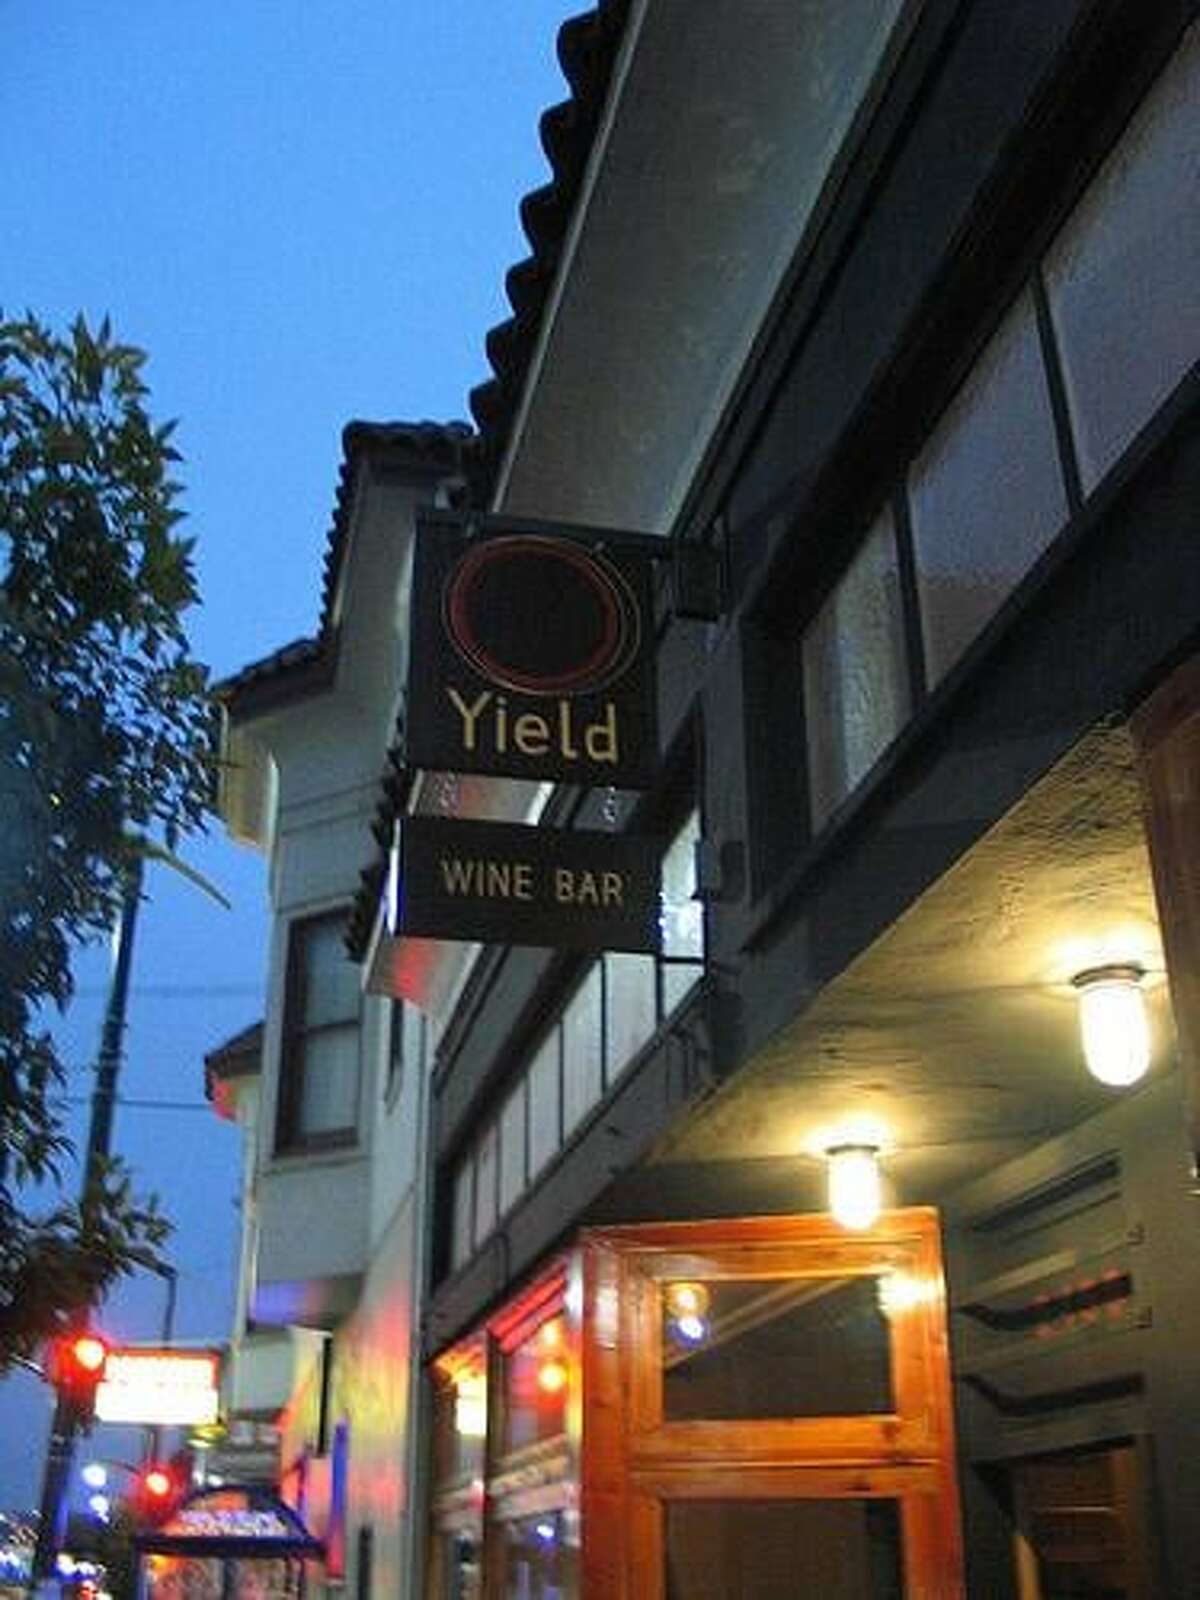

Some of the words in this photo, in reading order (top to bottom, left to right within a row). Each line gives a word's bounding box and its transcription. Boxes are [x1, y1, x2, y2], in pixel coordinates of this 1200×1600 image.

[448, 688, 619, 763] Yield
[441, 858, 533, 902] WINE
[554, 870, 625, 907] BAR
